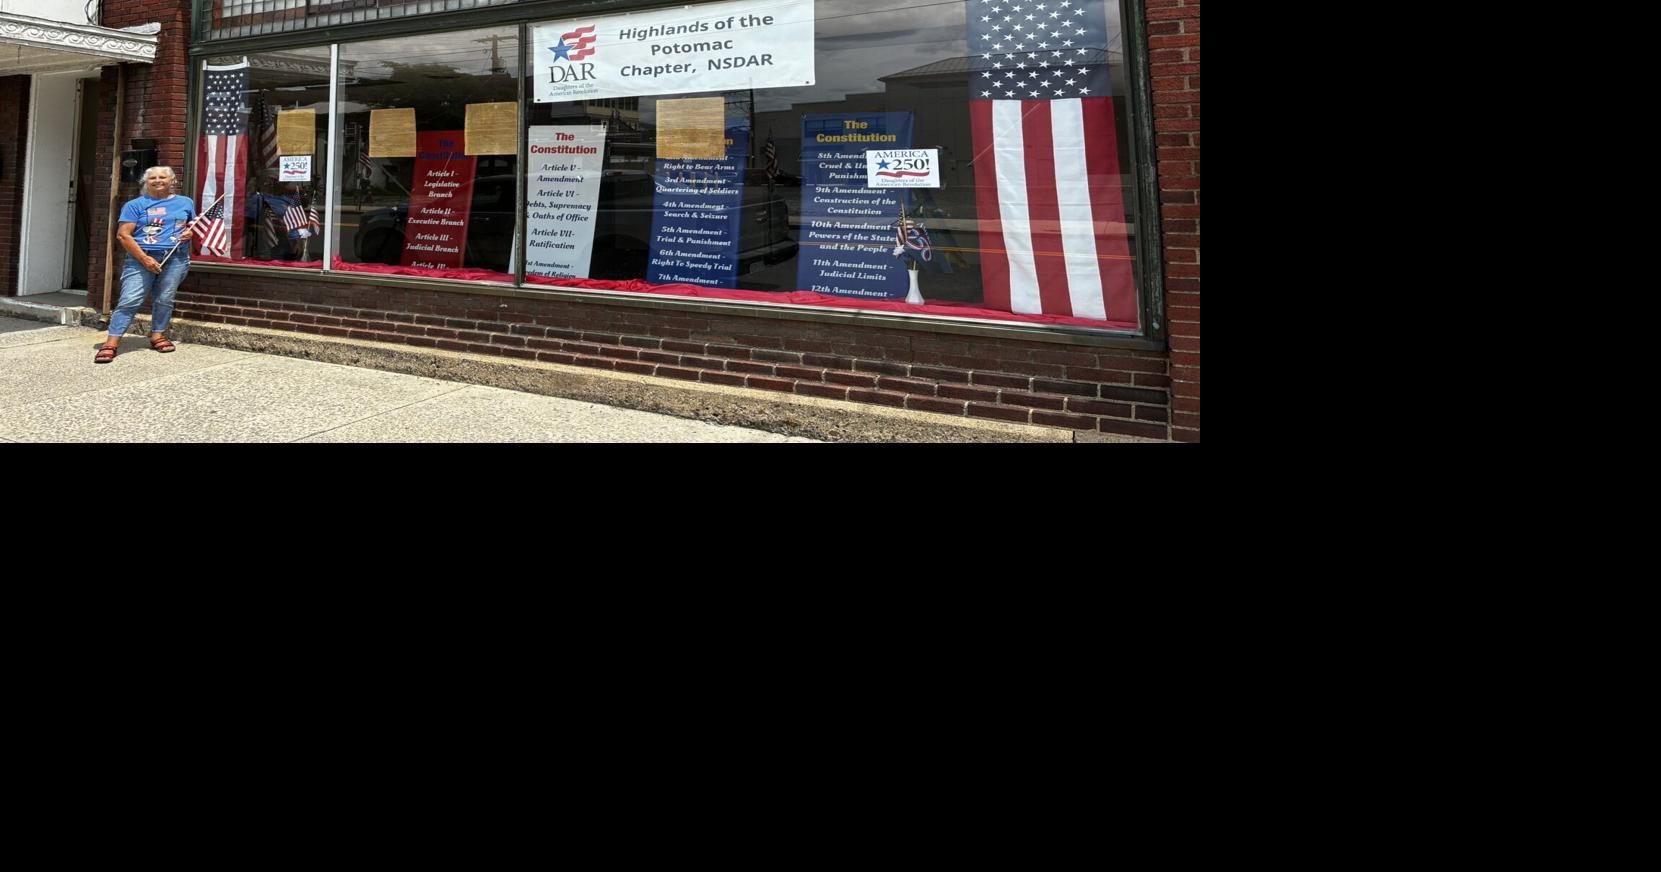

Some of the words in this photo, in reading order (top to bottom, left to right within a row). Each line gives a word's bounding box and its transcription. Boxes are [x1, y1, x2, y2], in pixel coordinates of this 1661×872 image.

[619, 22, 709, 41] Highlands
[715, 17, 734, 30] of
[742, 14, 774, 27] the
[651, 39, 733, 56] Potomac
[620, 62, 697, 78] Chapter,
[708, 54, 773, 71] NSDAR
[548, 62, 597, 83] DAR
[844, 120, 868, 129] The
[555, 132, 575, 141] The
[816, 134, 896, 142] Constitution
[530, 144, 597, 154] Constitution
[663, 163, 684, 171] Right
[893, 159, 930, 170] 250!
[537, 175, 584, 183] Amendment
[424, 181, 460, 189] Legislative
[537, 189, 563, 197] Article
[656, 186, 698, 194] Quartering
[709, 187, 739, 195] Soldiers
[816, 186, 831, 194] 9th
[814, 196, 870, 205] Construction
[871, 197, 880, 206] of
[549, 201, 592, 211] Supremacy
[421, 207, 444, 215] Article
[827, 207, 882, 215] Constitution
[532, 212, 555, 220] Oaths
[556, 213, 564, 221] of
[565, 214, 589, 222] Office
[700, 212, 728, 220] Seizure
[408, 217, 440, 225] Executive
[811, 220, 832, 228] 10th
[834, 221, 891, 231] Amendment
[531, 228, 558, 237] Article
[676, 227, 723, 235] Amendment
[415, 232, 439, 241] Article
[808, 231, 841, 239] Powers
[842, 232, 852, 240] of
[854, 233, 870, 241] the
[871, 233, 897, 242] State
[529, 240, 575, 250] Ratification
[686, 237, 732, 246] Punishment
[406, 243, 434, 251] Judicial
[434, 245, 459, 253] Branch
[840, 243, 855, 251] the
[857, 245, 888, 253] People
[675, 250, 721, 259] Amendment
[411, 261, 434, 269] Article
[533, 261, 570, 269] Amendment
[652, 259, 674, 267] Right
[685, 261, 712, 270] Speedy
[713, 263, 732, 271] Trial
[832, 260, 887, 270] Amendment
[672, 274, 718, 285] Amendment
[819, 270, 855, 279] Judicial
[857, 272, 886, 281] Limits
[832, 287, 887, 297] Amendment
